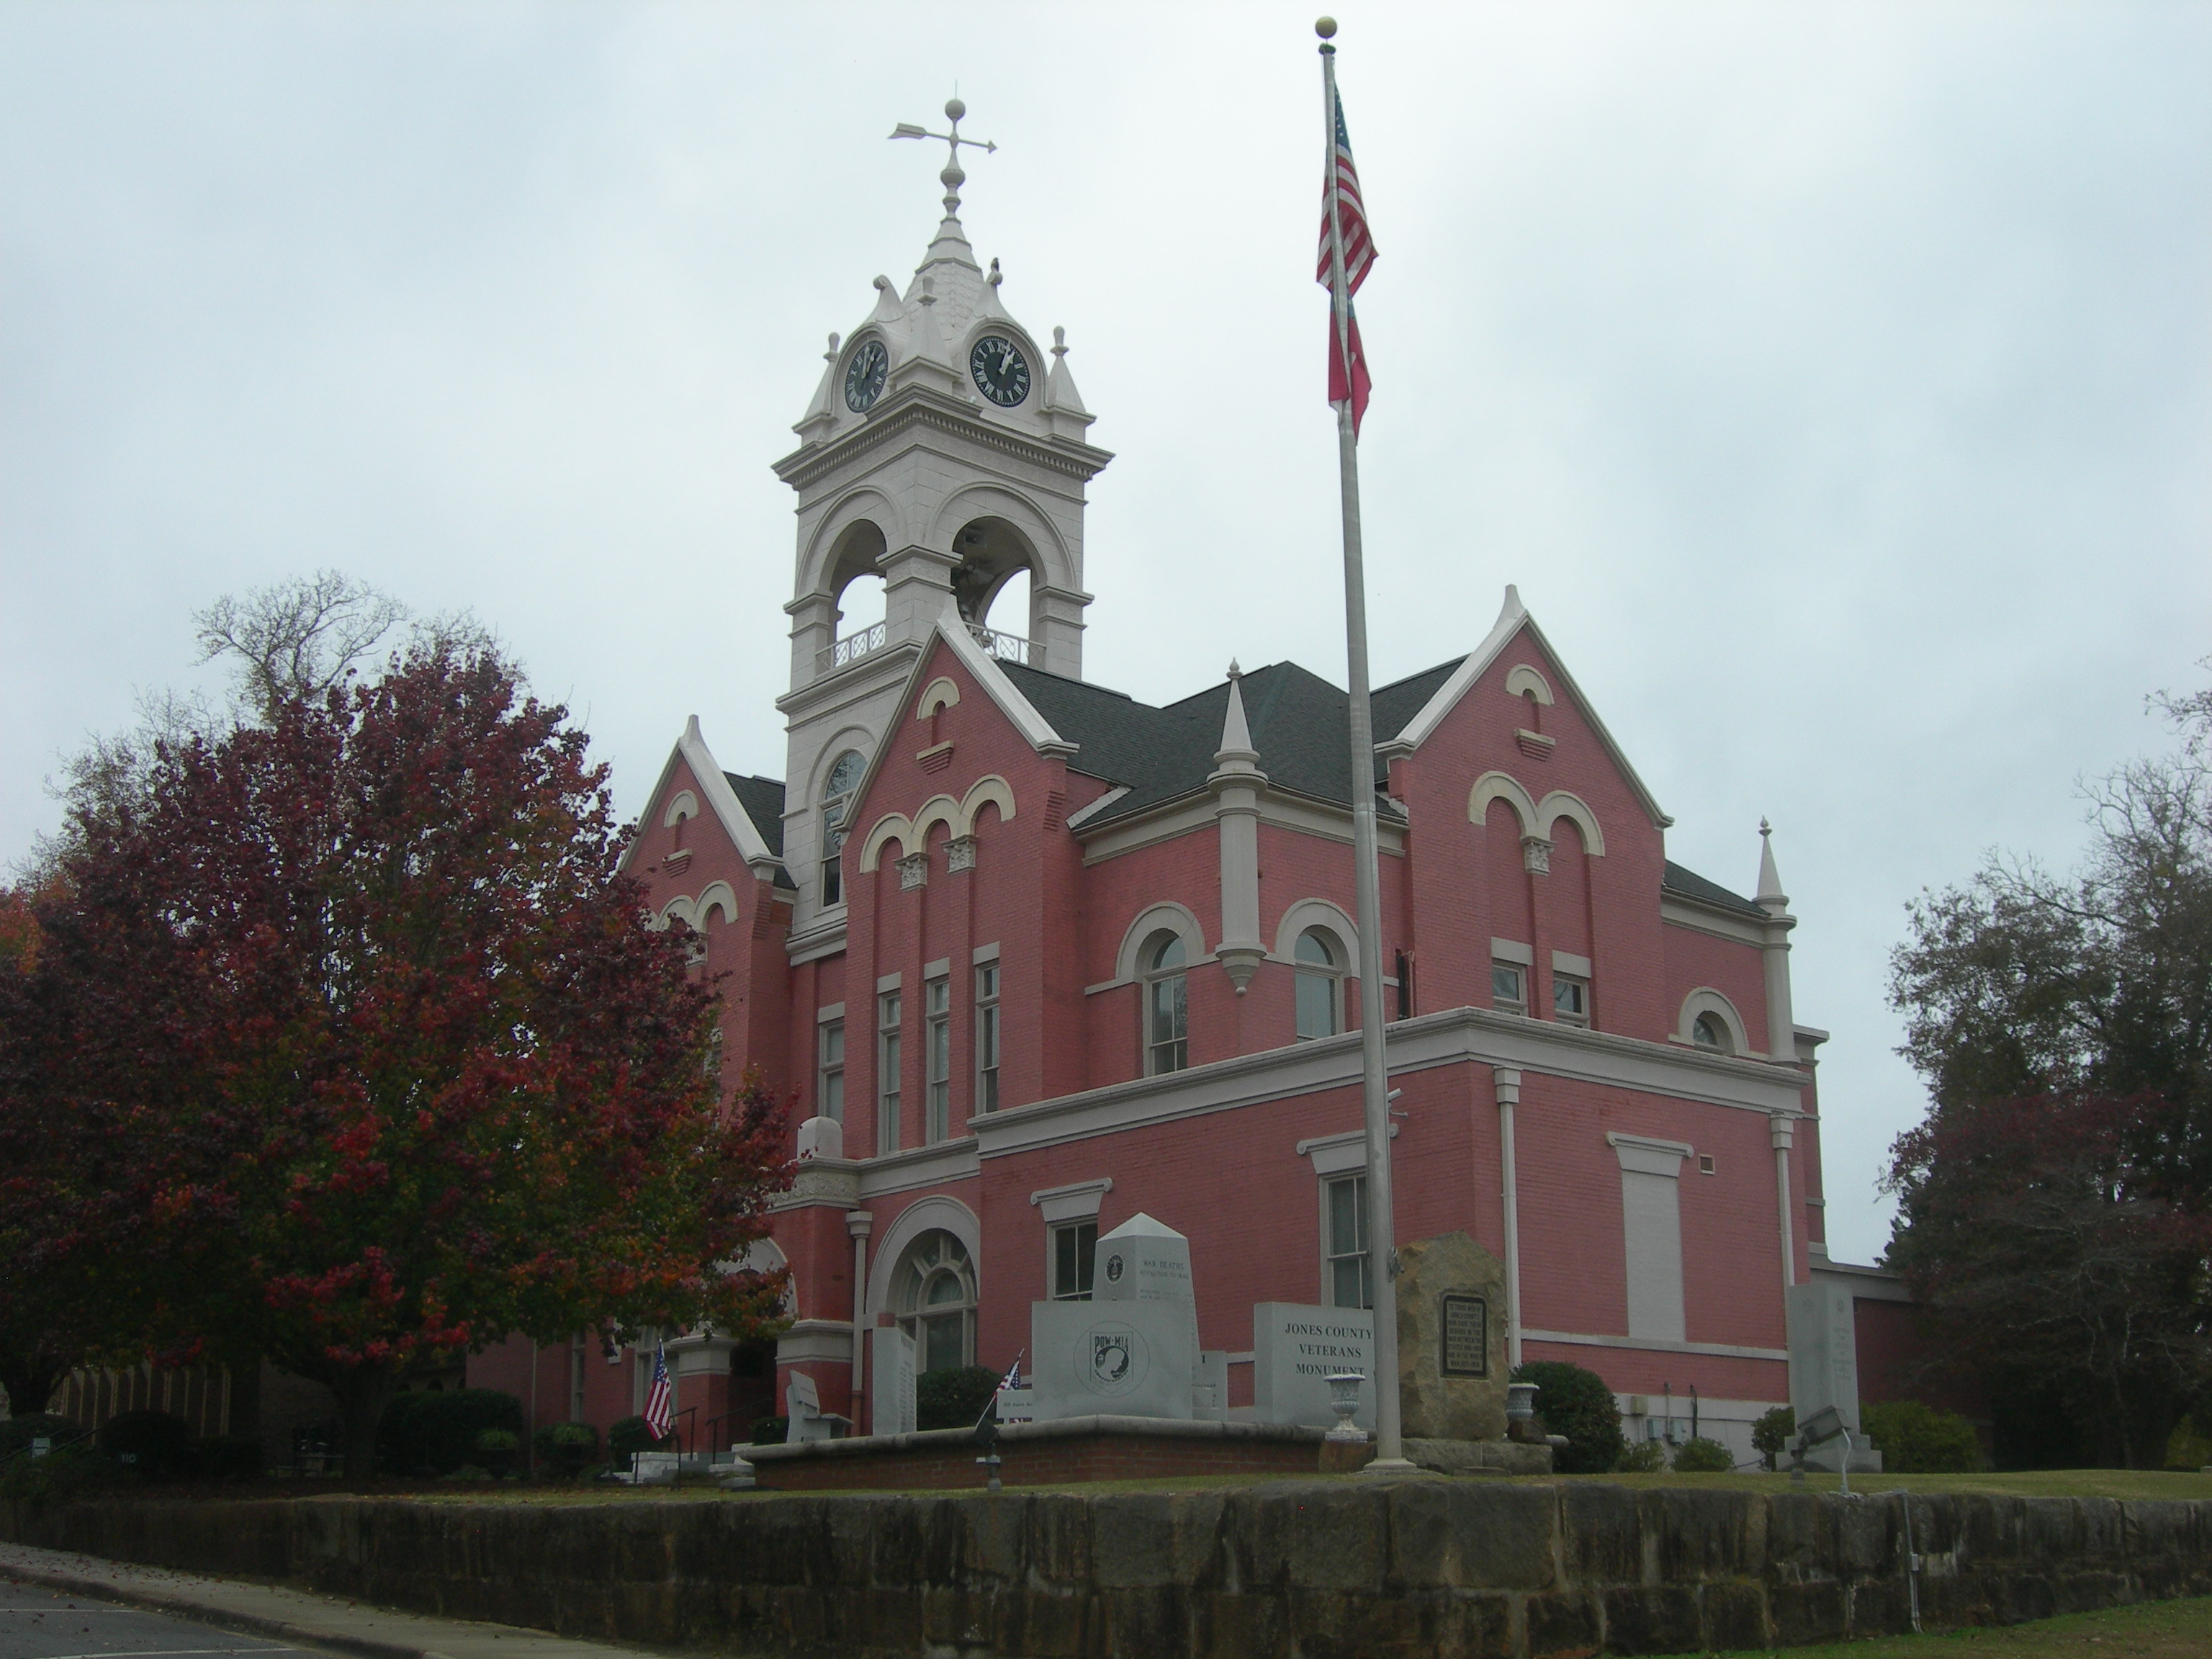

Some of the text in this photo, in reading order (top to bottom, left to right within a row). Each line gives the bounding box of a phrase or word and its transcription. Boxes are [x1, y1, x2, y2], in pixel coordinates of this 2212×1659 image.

[977, 347, 988, 359] X
[986, 341, 996, 354] XI
[1006, 390, 1015, 403] V
[1142, 1259, 1184, 1270] WAR DEATHS
[1285, 1323, 1372, 1340] JONES COUNTY
[1299, 1344, 1361, 1359] VETERANS
[1296, 1363, 1364, 1376] MONUMENT
[121, 1454, 137, 1464] 110
